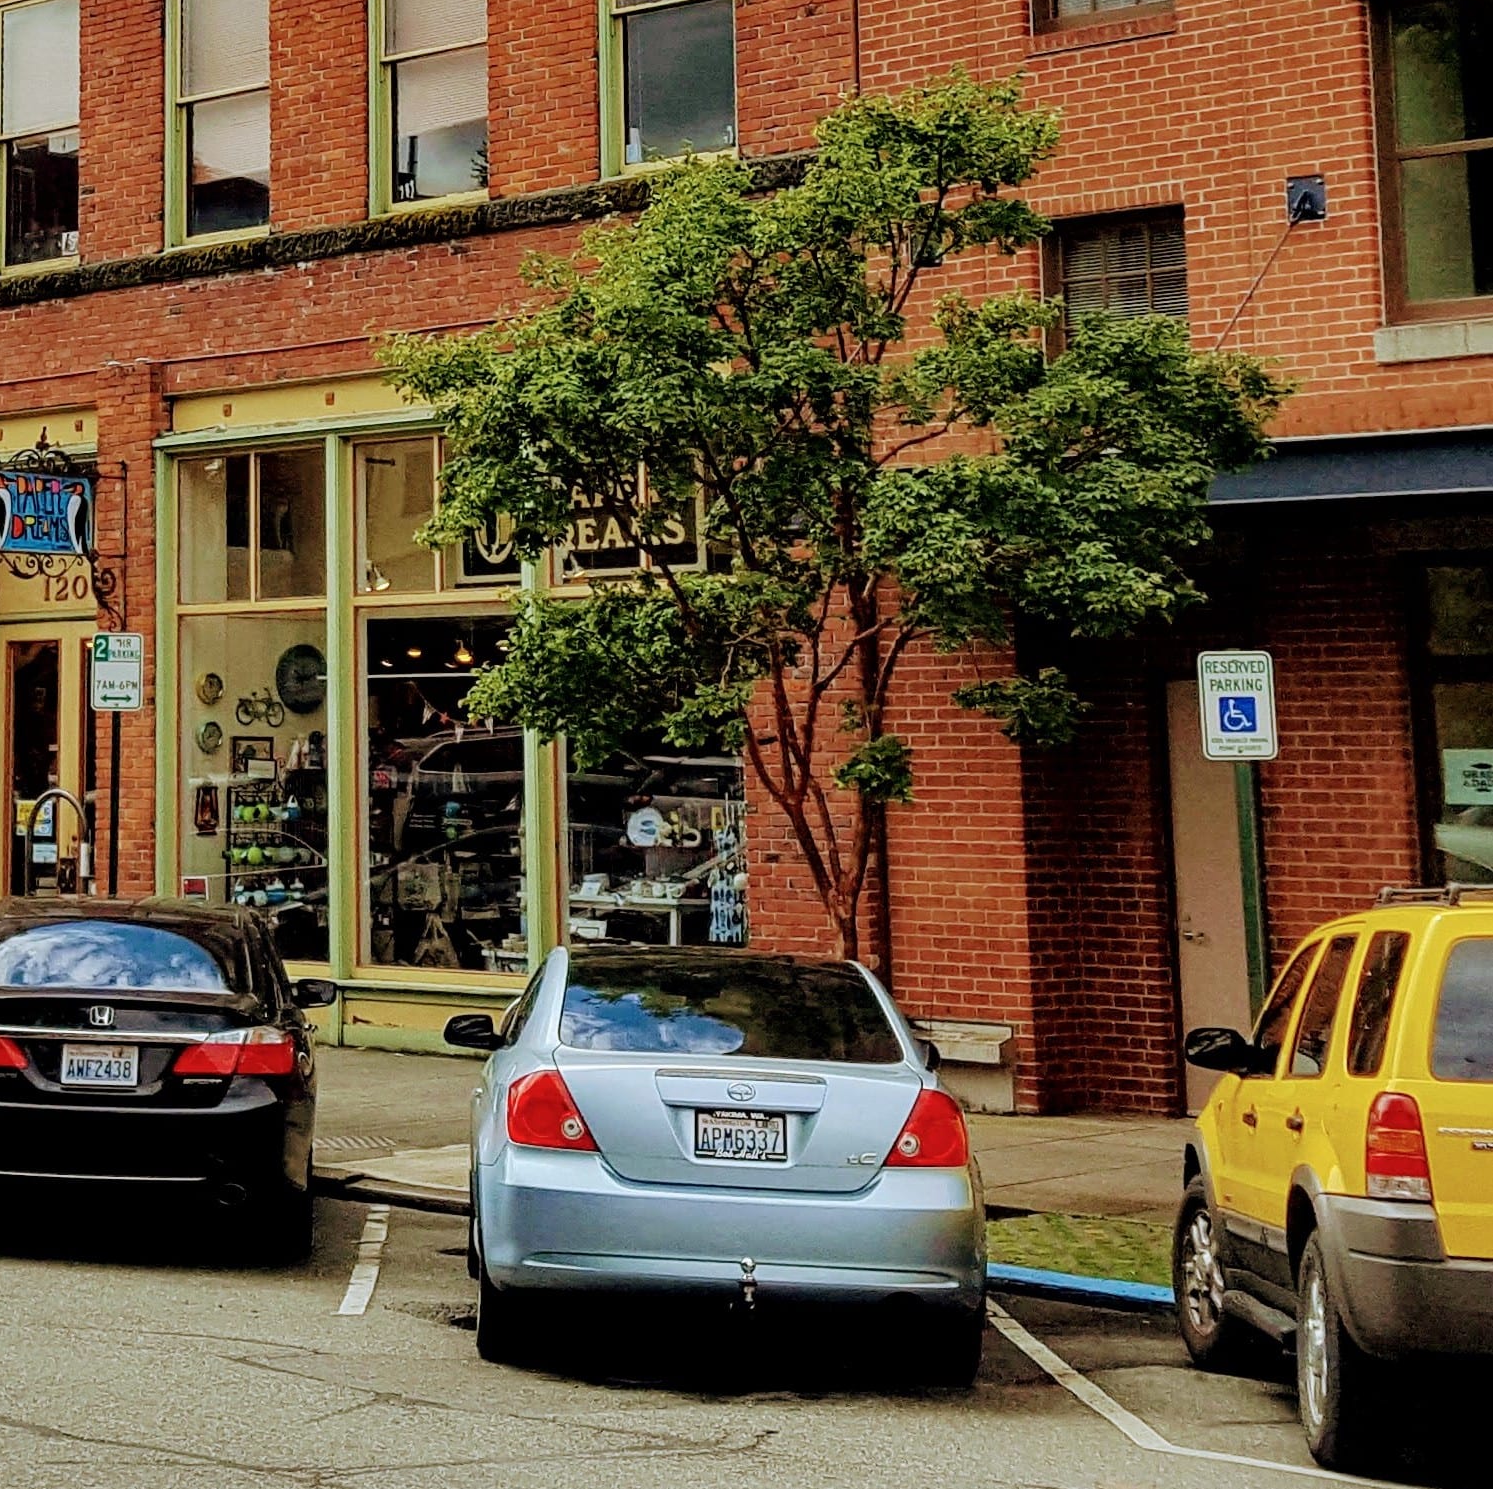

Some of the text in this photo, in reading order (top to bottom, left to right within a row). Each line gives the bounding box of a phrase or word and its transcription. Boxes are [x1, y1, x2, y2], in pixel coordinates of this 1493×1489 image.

[11, 514, 70, 543] DREAMS
[563, 514, 686, 551] REAS
[44, 574, 89, 602] 120
[95, 638, 107, 658] 2
[1205, 660, 1266, 674] RESERVED
[96, 680, 138, 690] 7AM-6PM
[1210, 678, 1263, 692] PARKING
[66, 1058, 131, 1079] AWF2438
[701, 1127, 780, 1152] APM6337
